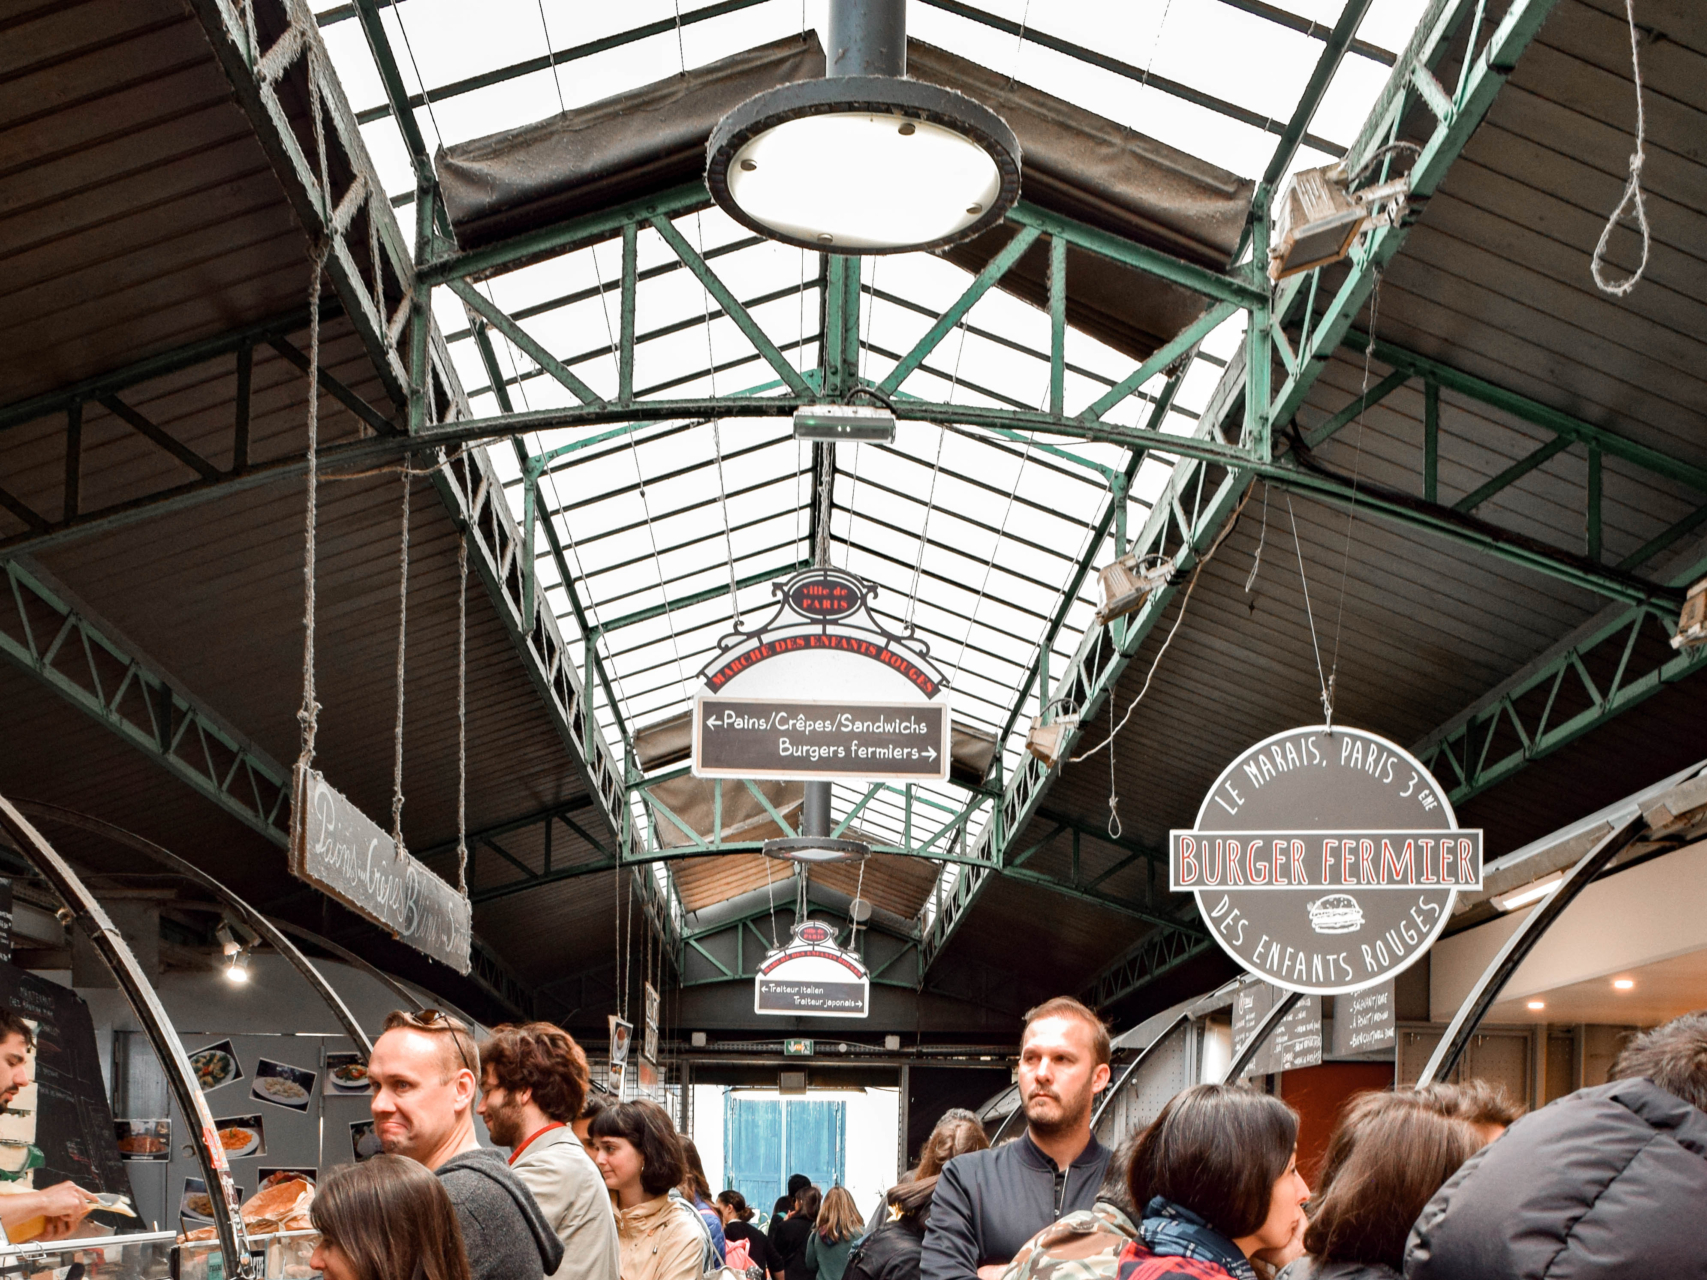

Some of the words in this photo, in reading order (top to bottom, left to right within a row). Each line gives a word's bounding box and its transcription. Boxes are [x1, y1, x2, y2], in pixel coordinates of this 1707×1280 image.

[802, 584, 830, 596] ville
[833, 585, 848, 596] de
[802, 599, 848, 610] PARIS
[775, 636, 805, 652] DES
[810, 635, 877, 657] ENFANTS
[880, 648, 934, 694] ROUGES
[779, 737, 846, 761] Burgers
[850, 740, 919, 760] fermiers
[1214, 779, 1245, 816] LE
[1243, 736, 1328, 789] MARAIS,
[1341, 736, 1398, 784] PARIS
[1179, 836, 1309, 886] BURGER
[1321, 838, 1476, 886] FERMIER
[1210, 894, 1249, 947] DES
[1252, 934, 1354, 983] ENFANTS
[1361, 894, 1441, 973] ROUGES
[768, 983, 799, 994] Traiteur
[793, 995, 824, 1006] Traiteur
